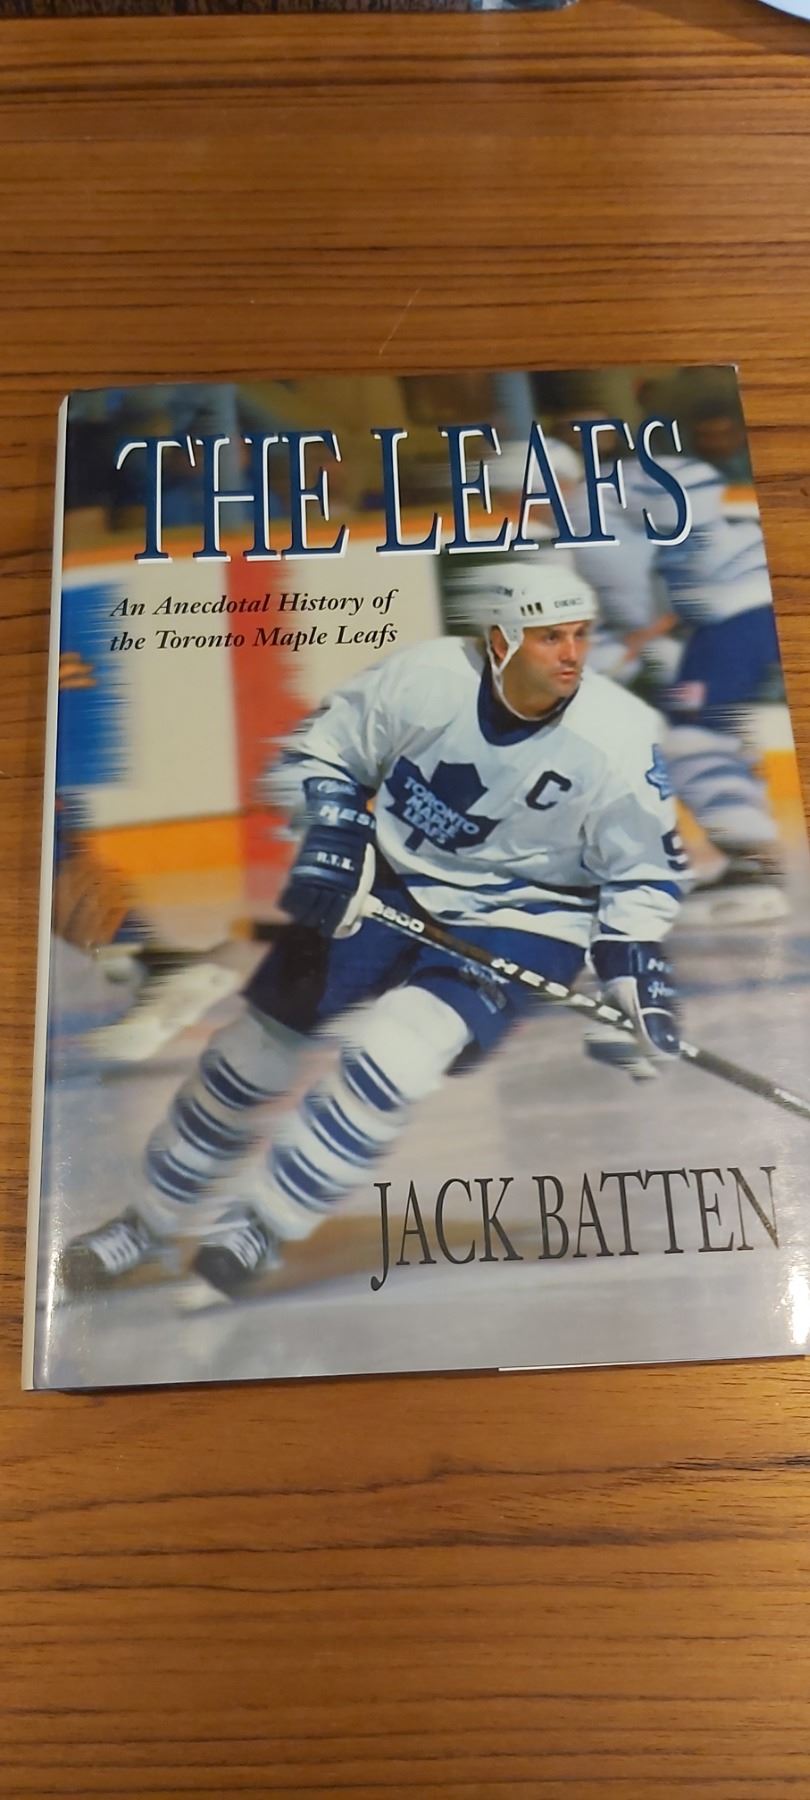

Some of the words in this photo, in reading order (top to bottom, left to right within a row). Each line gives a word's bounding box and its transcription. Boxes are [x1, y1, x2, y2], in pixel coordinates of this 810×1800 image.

[116, 430, 350, 565] THE
[371, 417, 693, 557] LEAFS
[109, 597, 146, 617] An
[152, 593, 271, 616] Anecdotal
[276, 591, 364, 616] History
[371, 588, 399, 615] of
[109, 632, 146, 652] the
[155, 629, 246, 650] Toronto
[252, 626, 328, 652] Maple
[335, 623, 398, 650] Leafs
[403, 775, 480, 835] TORONTO
[525, 769, 573, 812] C
[319, 804, 377, 830] HES
[405, 795, 456, 839] MAPLE
[370, 1176, 524, 1291] JACK
[531, 1165, 780, 1260] BATTEN
